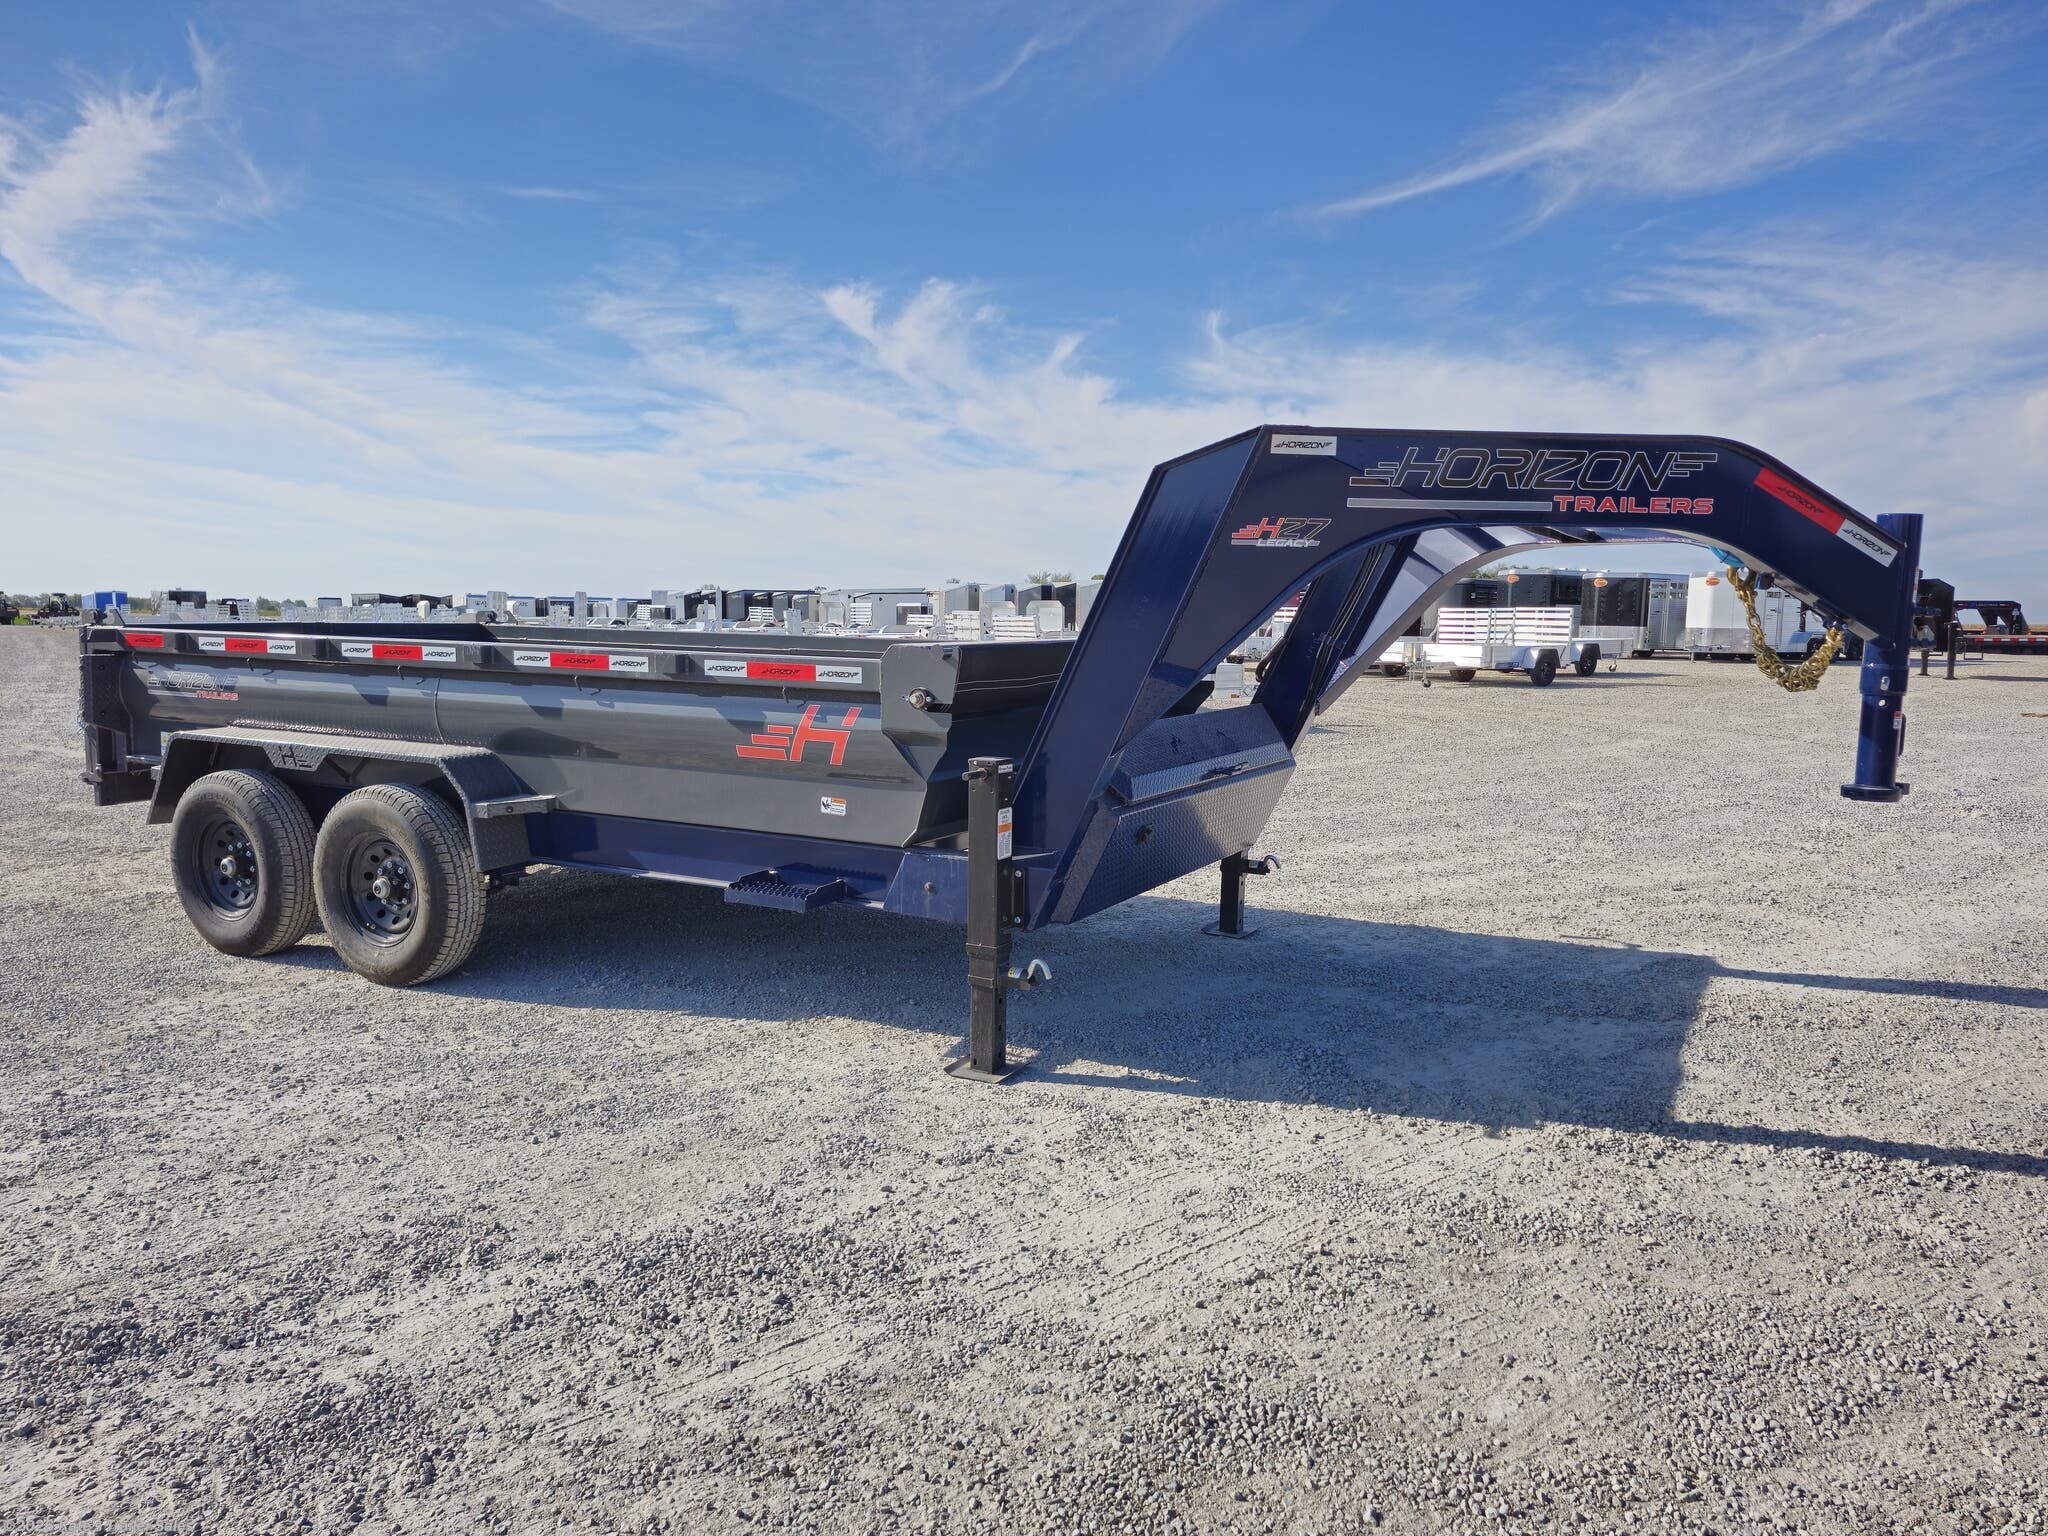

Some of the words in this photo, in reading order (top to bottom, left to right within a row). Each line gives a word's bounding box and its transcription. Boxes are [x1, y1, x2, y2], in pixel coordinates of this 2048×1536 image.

[1279, 440, 1326, 450] HORIZON
[1391, 446, 1677, 492] HORIZON
[1553, 495, 1714, 515] TRAILERS
[1779, 485, 1821, 513] HORIZON
[1253, 517, 1332, 540] H27
[1256, 538, 1313, 548] LEGACY
[1846, 528, 1887, 556] HORIZON
[566, 657, 593, 665] HORIZON
[710, 664, 741, 672] HORIZON
[764, 667, 797, 676] HORIZON
[196, 689, 239, 702] TRAILERS
